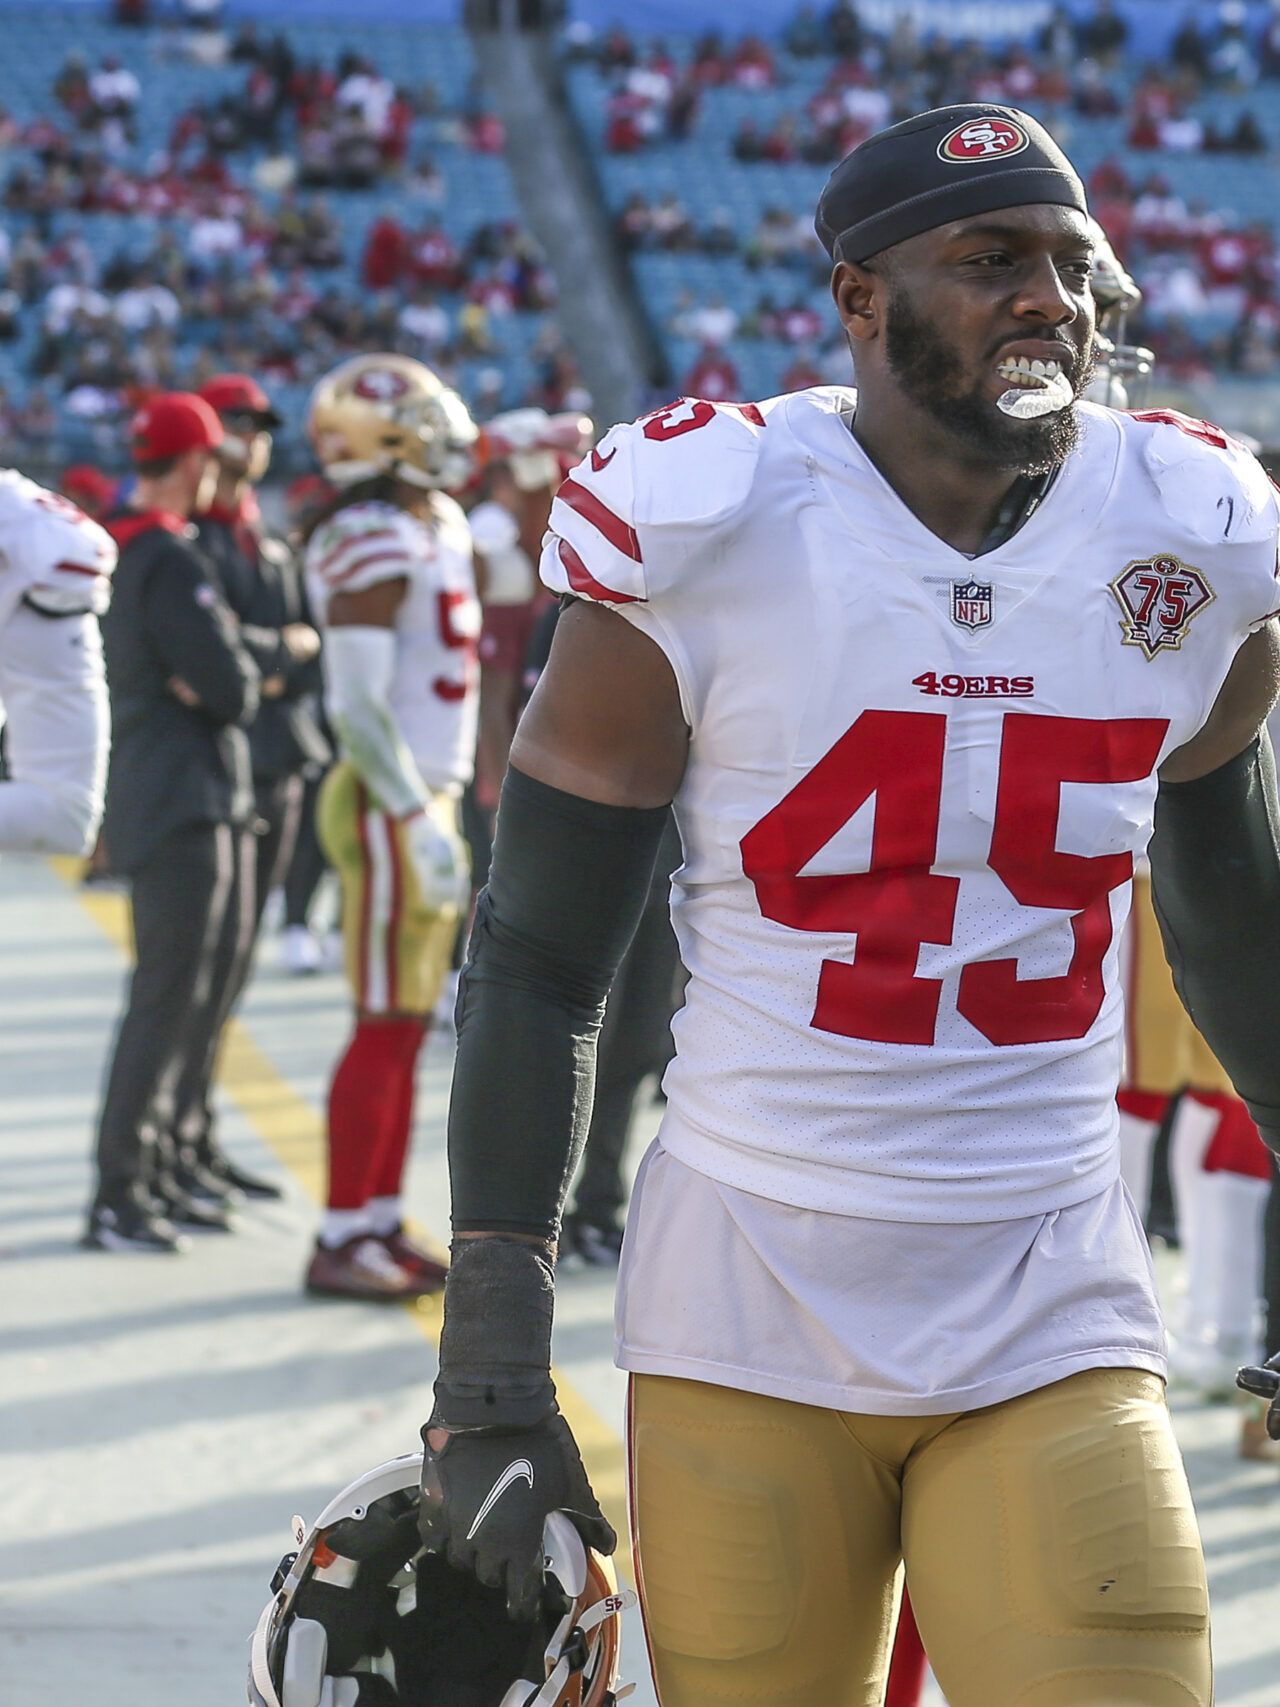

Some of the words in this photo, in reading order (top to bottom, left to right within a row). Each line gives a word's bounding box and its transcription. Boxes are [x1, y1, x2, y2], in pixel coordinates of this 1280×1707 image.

[960, 122, 1014, 155] SF
[957, 600, 988, 624] NFL
[1133, 574, 1193, 630] 75
[911, 671, 1034, 698] 49ERS
[739, 709, 1171, 1046] 45
